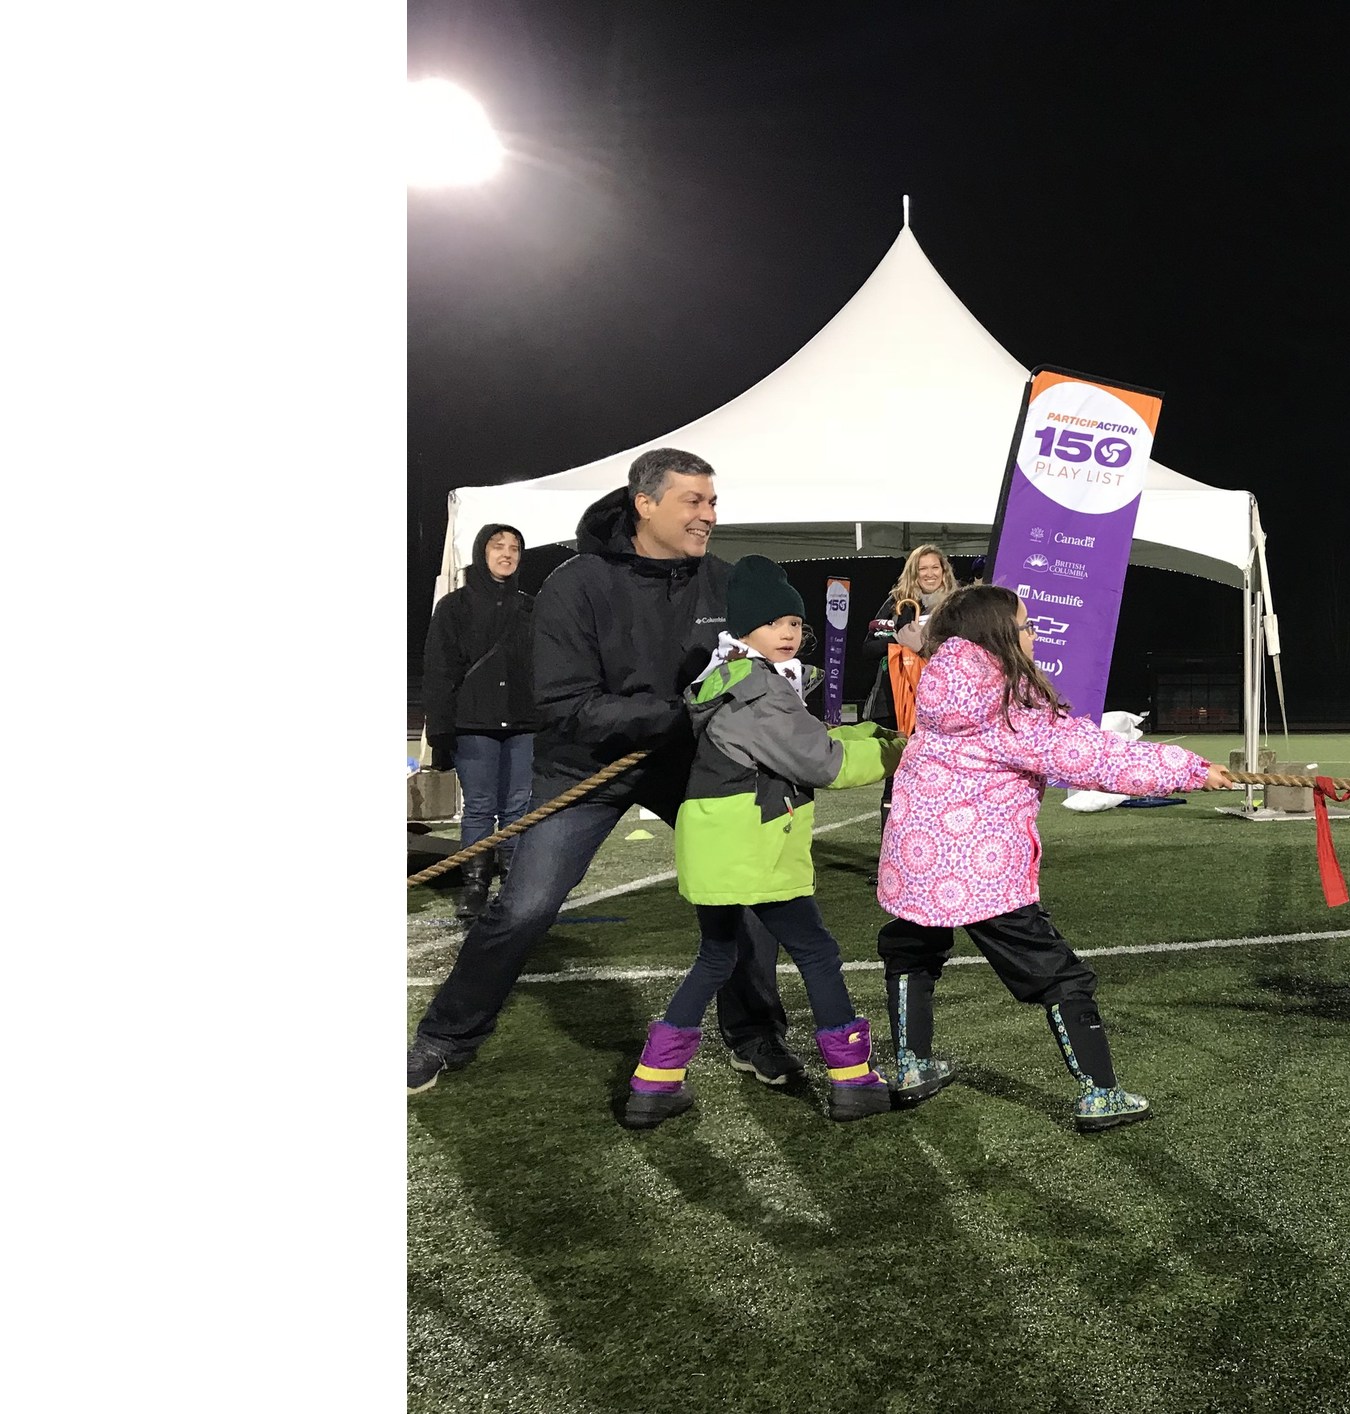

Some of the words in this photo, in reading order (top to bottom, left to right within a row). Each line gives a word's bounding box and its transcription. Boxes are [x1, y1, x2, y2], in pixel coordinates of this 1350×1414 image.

[1047, 412, 1138, 436] PARTICIPACTION
[1034, 426, 1132, 468] 150
[1035, 461, 1081, 480] PLAY
[1086, 470, 1124, 486] LIST
[1054, 532, 1095, 548] Canada
[1049, 565, 1088, 578] COLUMBIA
[1055, 559, 1086, 570] BRITISH
[1031, 589, 1084, 607] Manulife
[1035, 636, 1067, 646] VROLET
